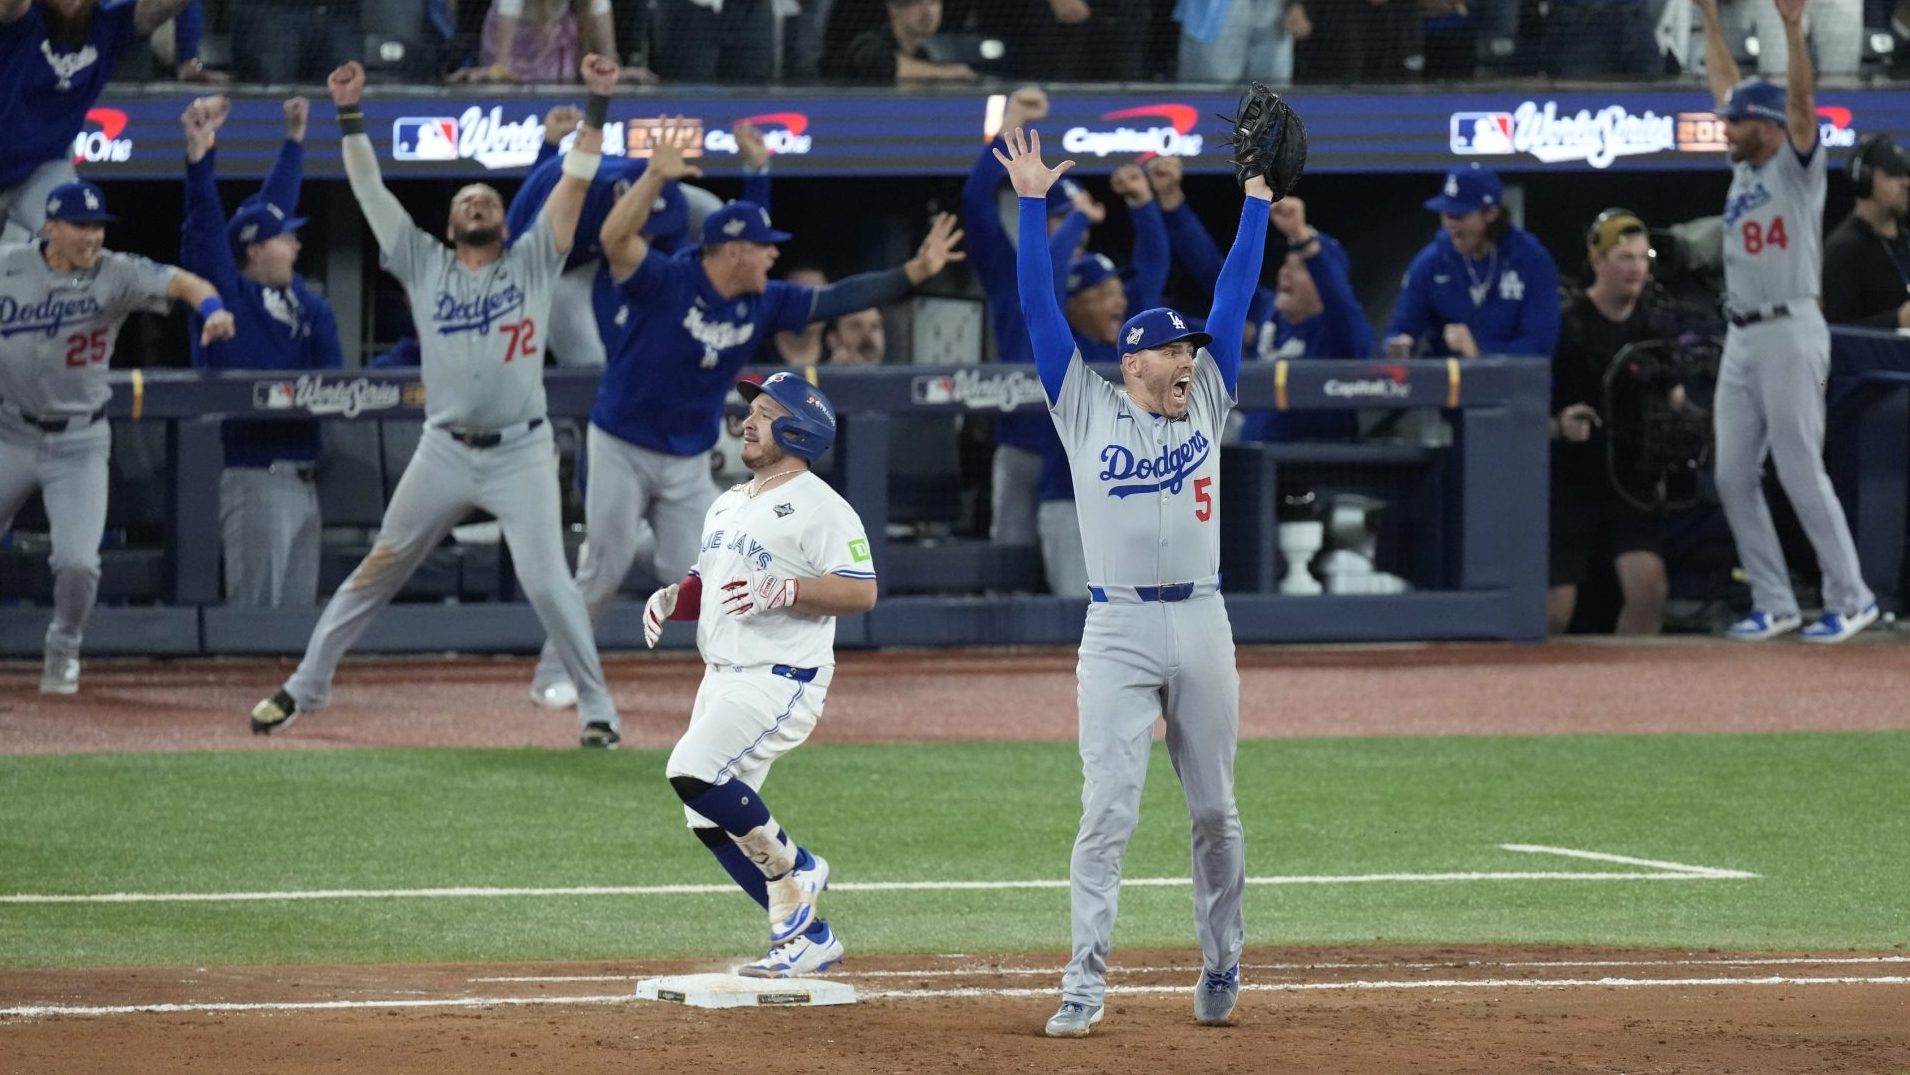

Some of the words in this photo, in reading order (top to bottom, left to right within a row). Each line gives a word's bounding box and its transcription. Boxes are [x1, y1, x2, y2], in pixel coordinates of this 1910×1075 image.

[1742, 214, 1788, 256] 84
[0, 290, 103, 338] Dodgers
[433, 284, 525, 336] Dodgers
[1167, 312, 1186, 329] LA
[66, 325, 109, 367] 25
[499, 318, 538, 362] 72
[1100, 430, 1210, 499] Dodgers
[1194, 477, 1212, 522] 5
[727, 530, 772, 570] JAYS
